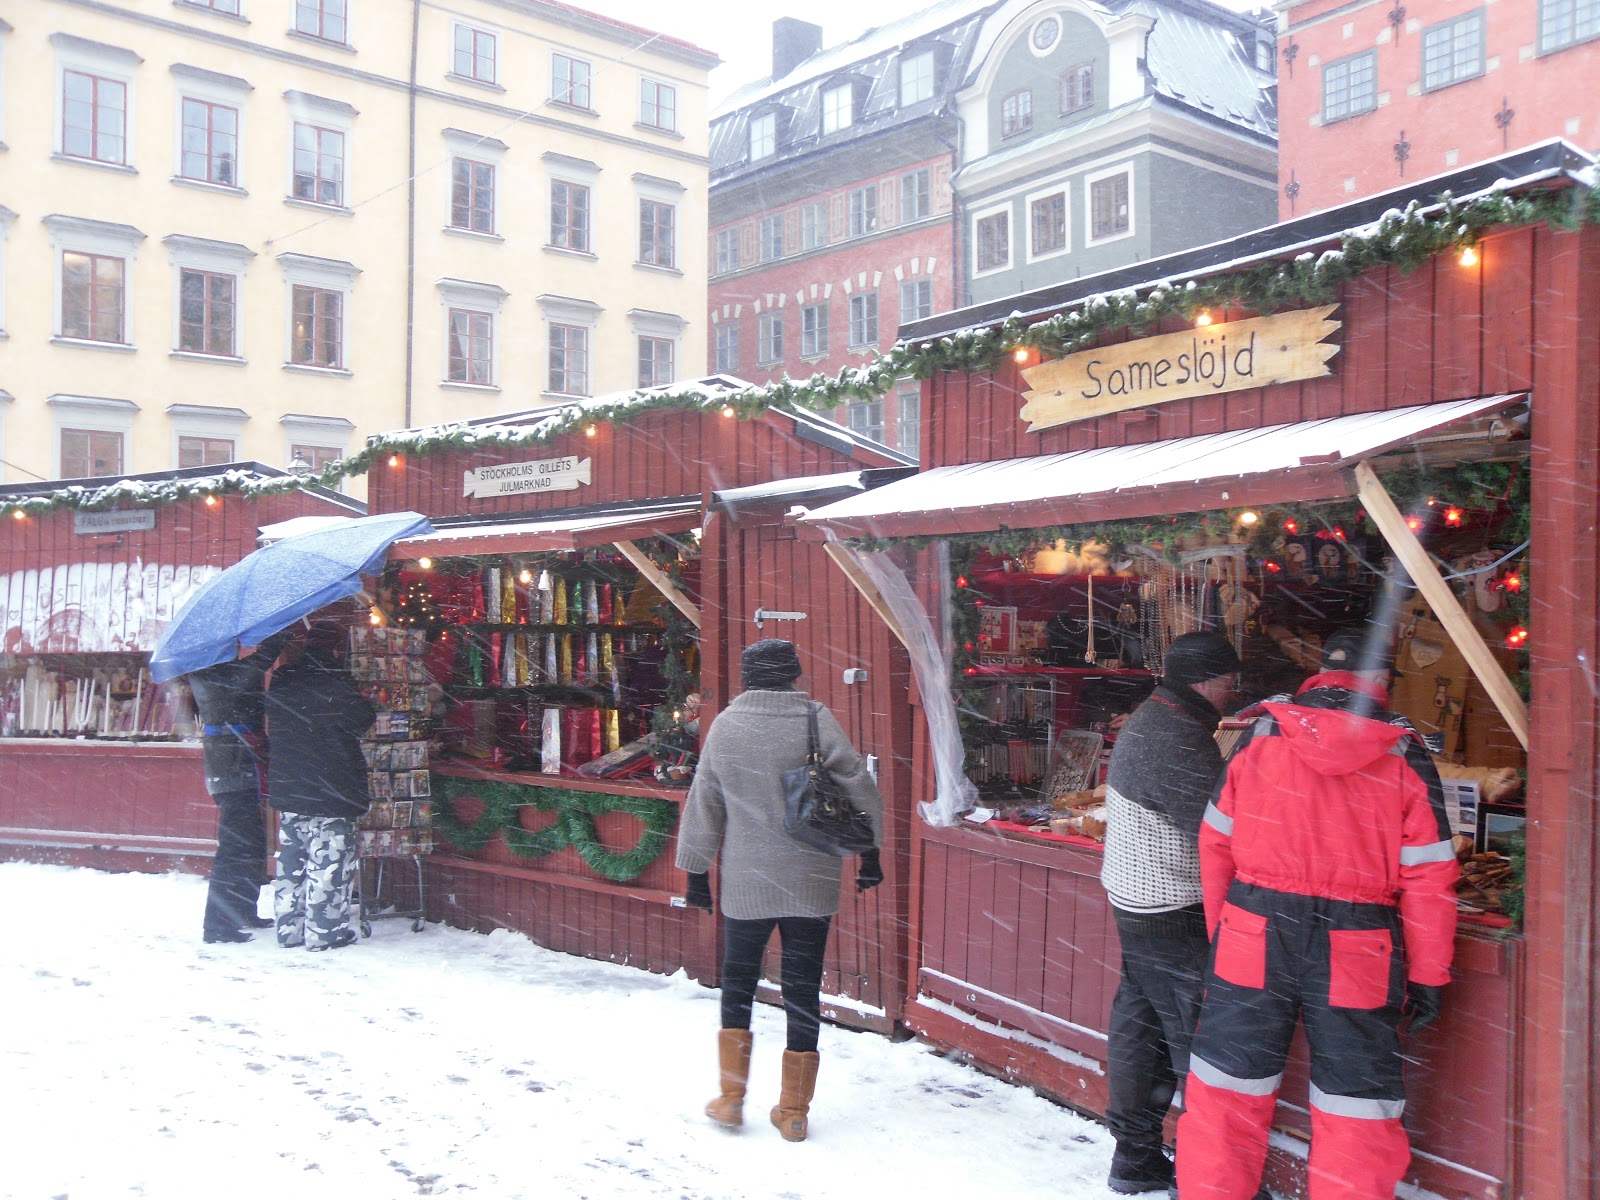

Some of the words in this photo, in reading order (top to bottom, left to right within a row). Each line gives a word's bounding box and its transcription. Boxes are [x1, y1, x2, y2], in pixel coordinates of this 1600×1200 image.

[1081, 331, 1255, 398] Sameslöjd
[480, 465, 533, 480] STOCKHOLMS
[539, 460, 571, 474] GILLETS
[499, 478, 551, 492] JULMARKNAD
